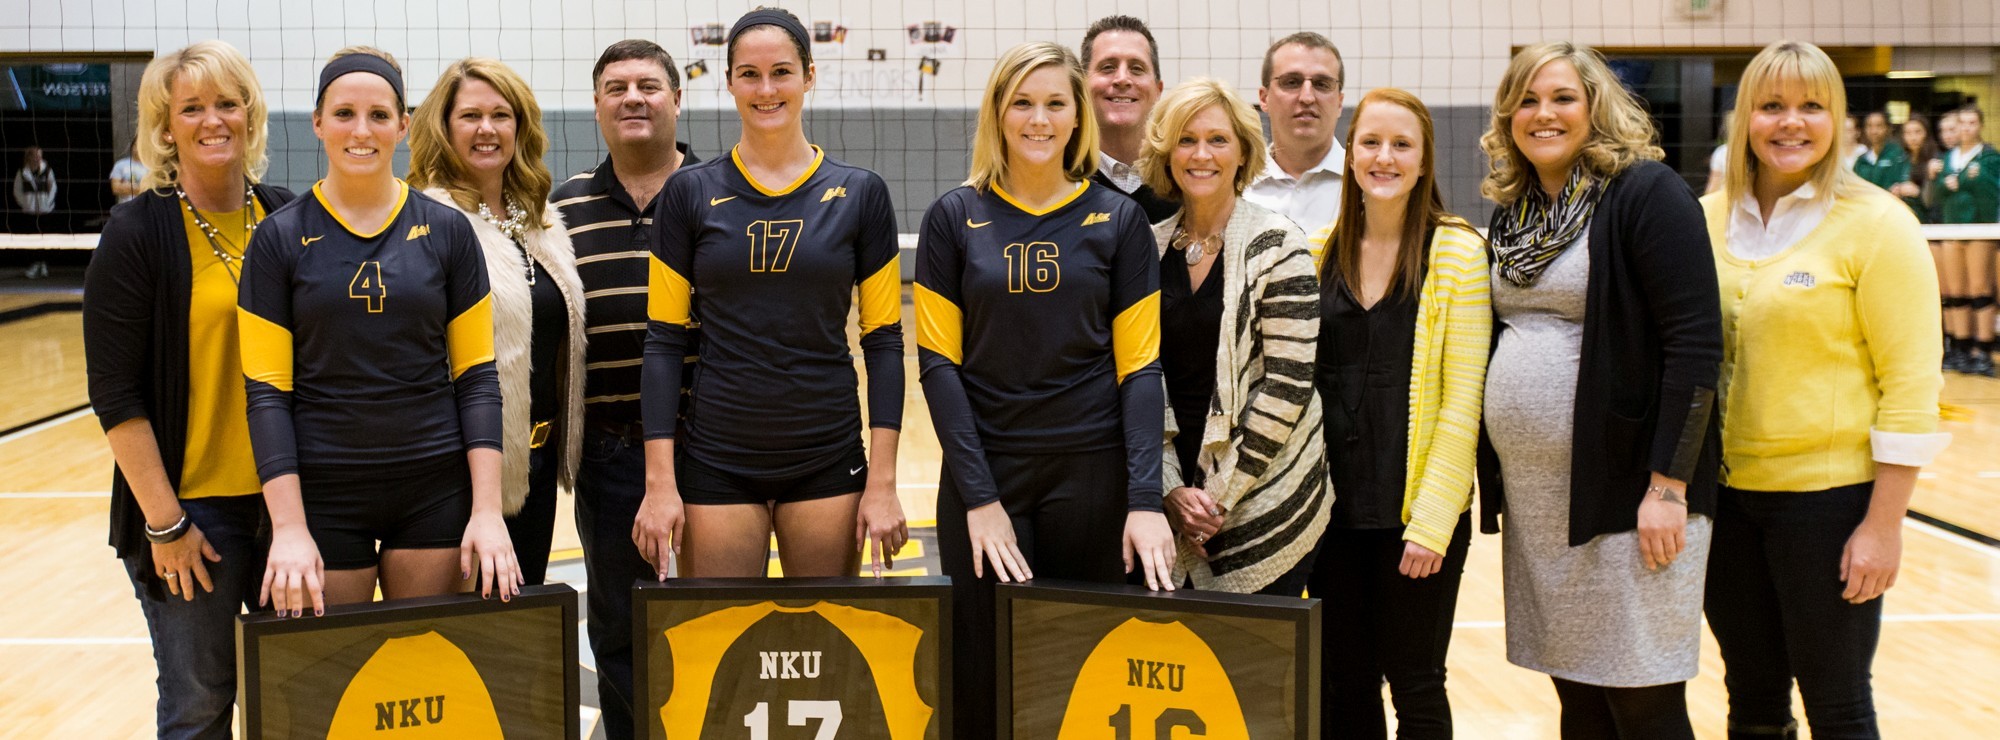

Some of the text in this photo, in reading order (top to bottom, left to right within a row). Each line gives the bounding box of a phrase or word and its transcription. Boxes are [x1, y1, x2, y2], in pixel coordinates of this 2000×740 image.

[747, 219, 803, 272] 17
[1004, 241, 1060, 293] 16
[349, 261, 386, 313] 4
[759, 651, 822, 679] NKU
[1127, 658, 1185, 692] NKU
[375, 695, 445, 730] NKU
